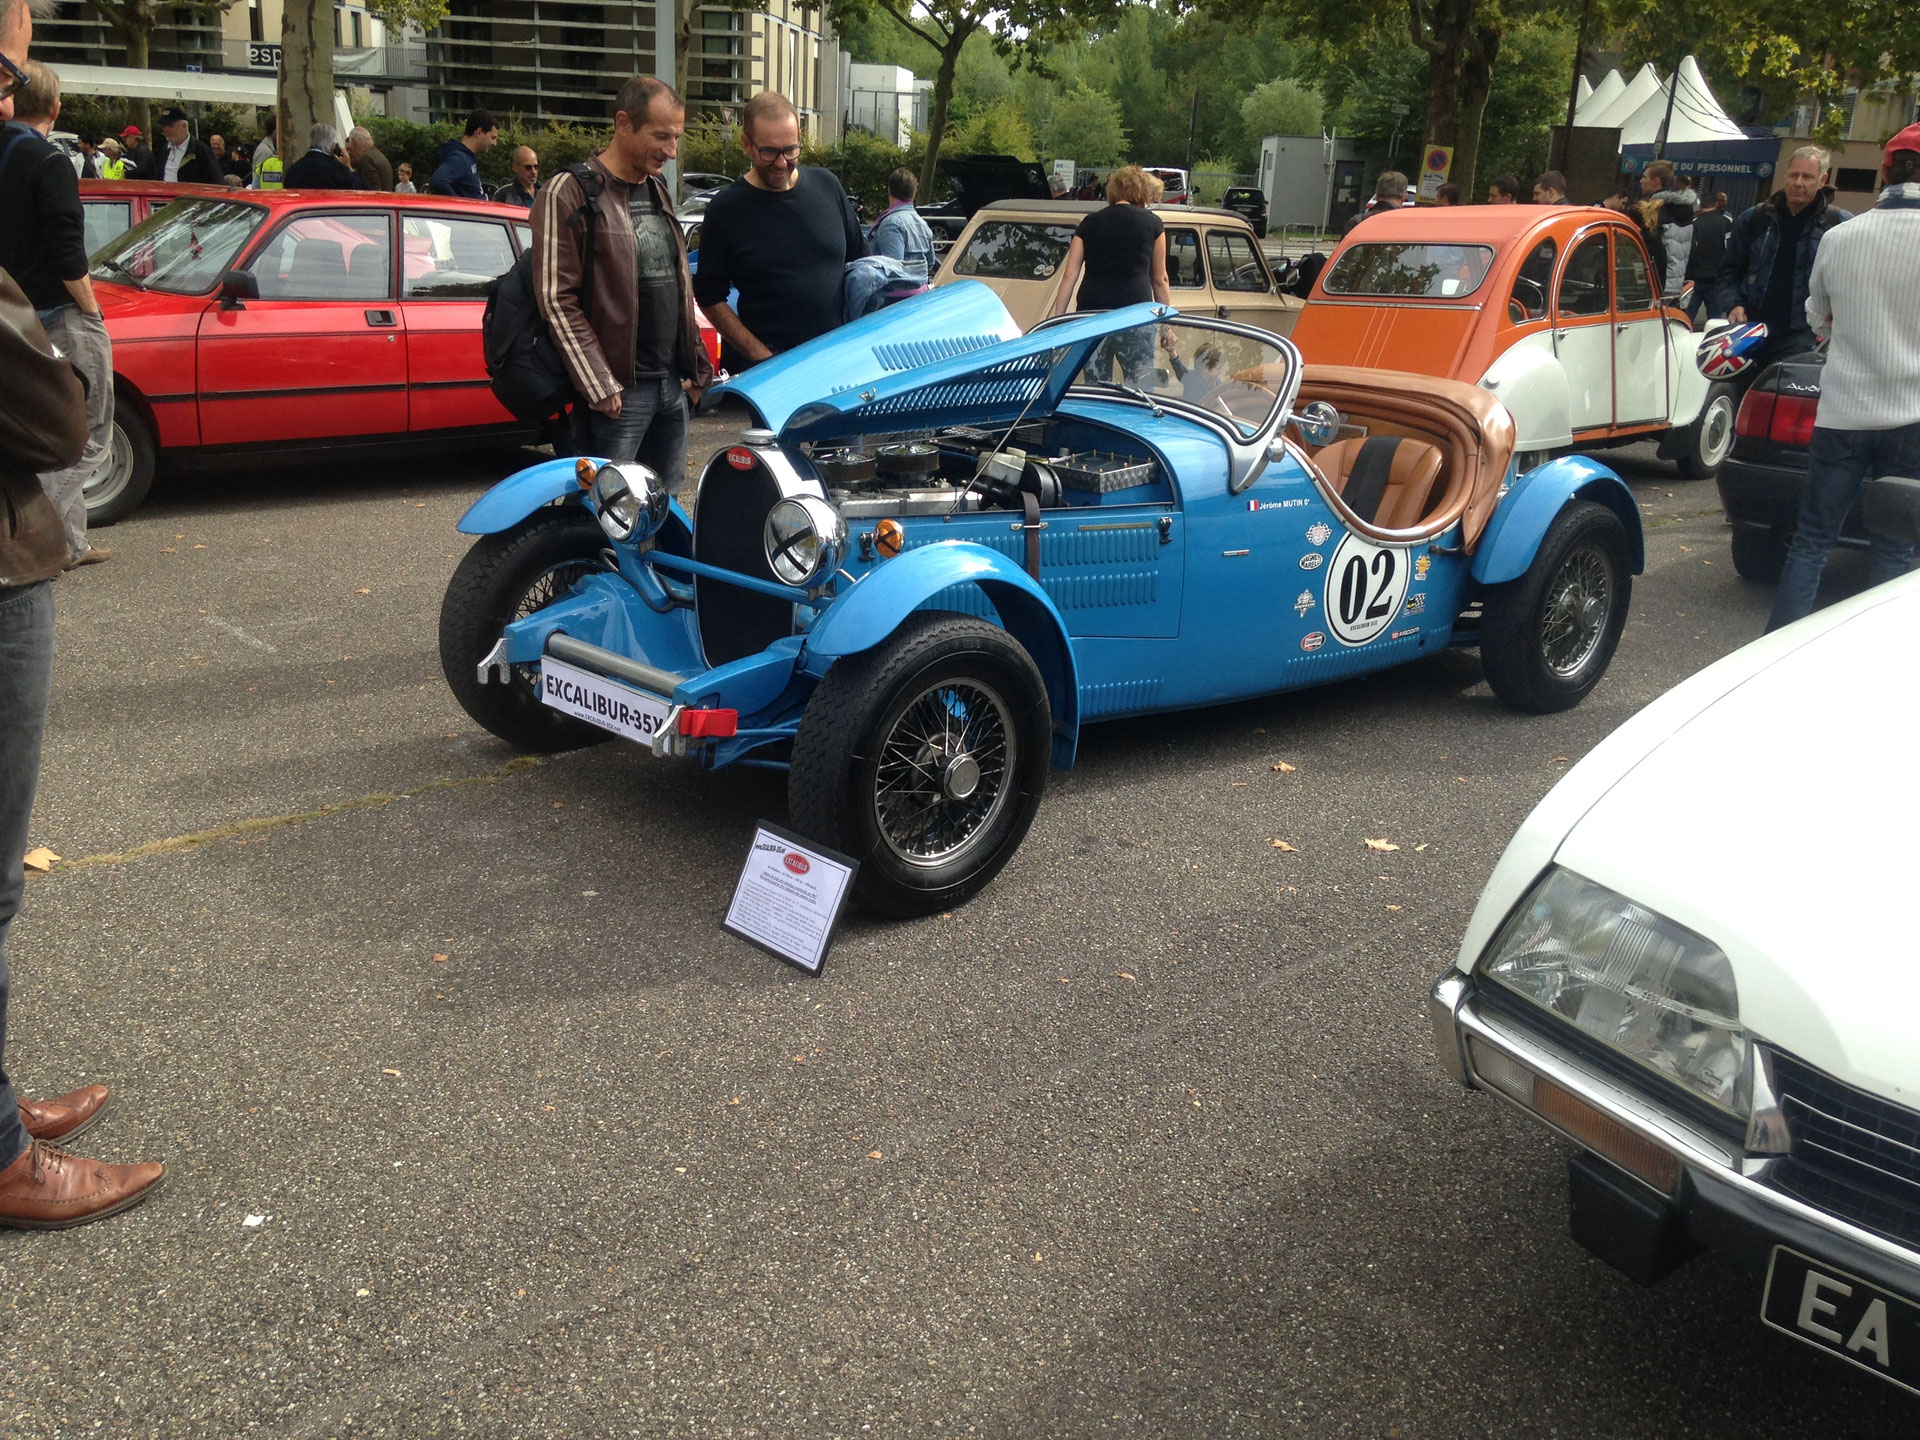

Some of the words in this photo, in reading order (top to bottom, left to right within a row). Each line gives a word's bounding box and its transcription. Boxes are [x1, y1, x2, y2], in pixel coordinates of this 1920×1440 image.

[1680, 162, 1694, 171] DU
[1697, 163, 1752, 173] PERSONNEL
[1282, 499, 1303, 507] MUTIN
[1339, 549, 1396, 625] 02
[1797, 1269, 1890, 1367] EA
